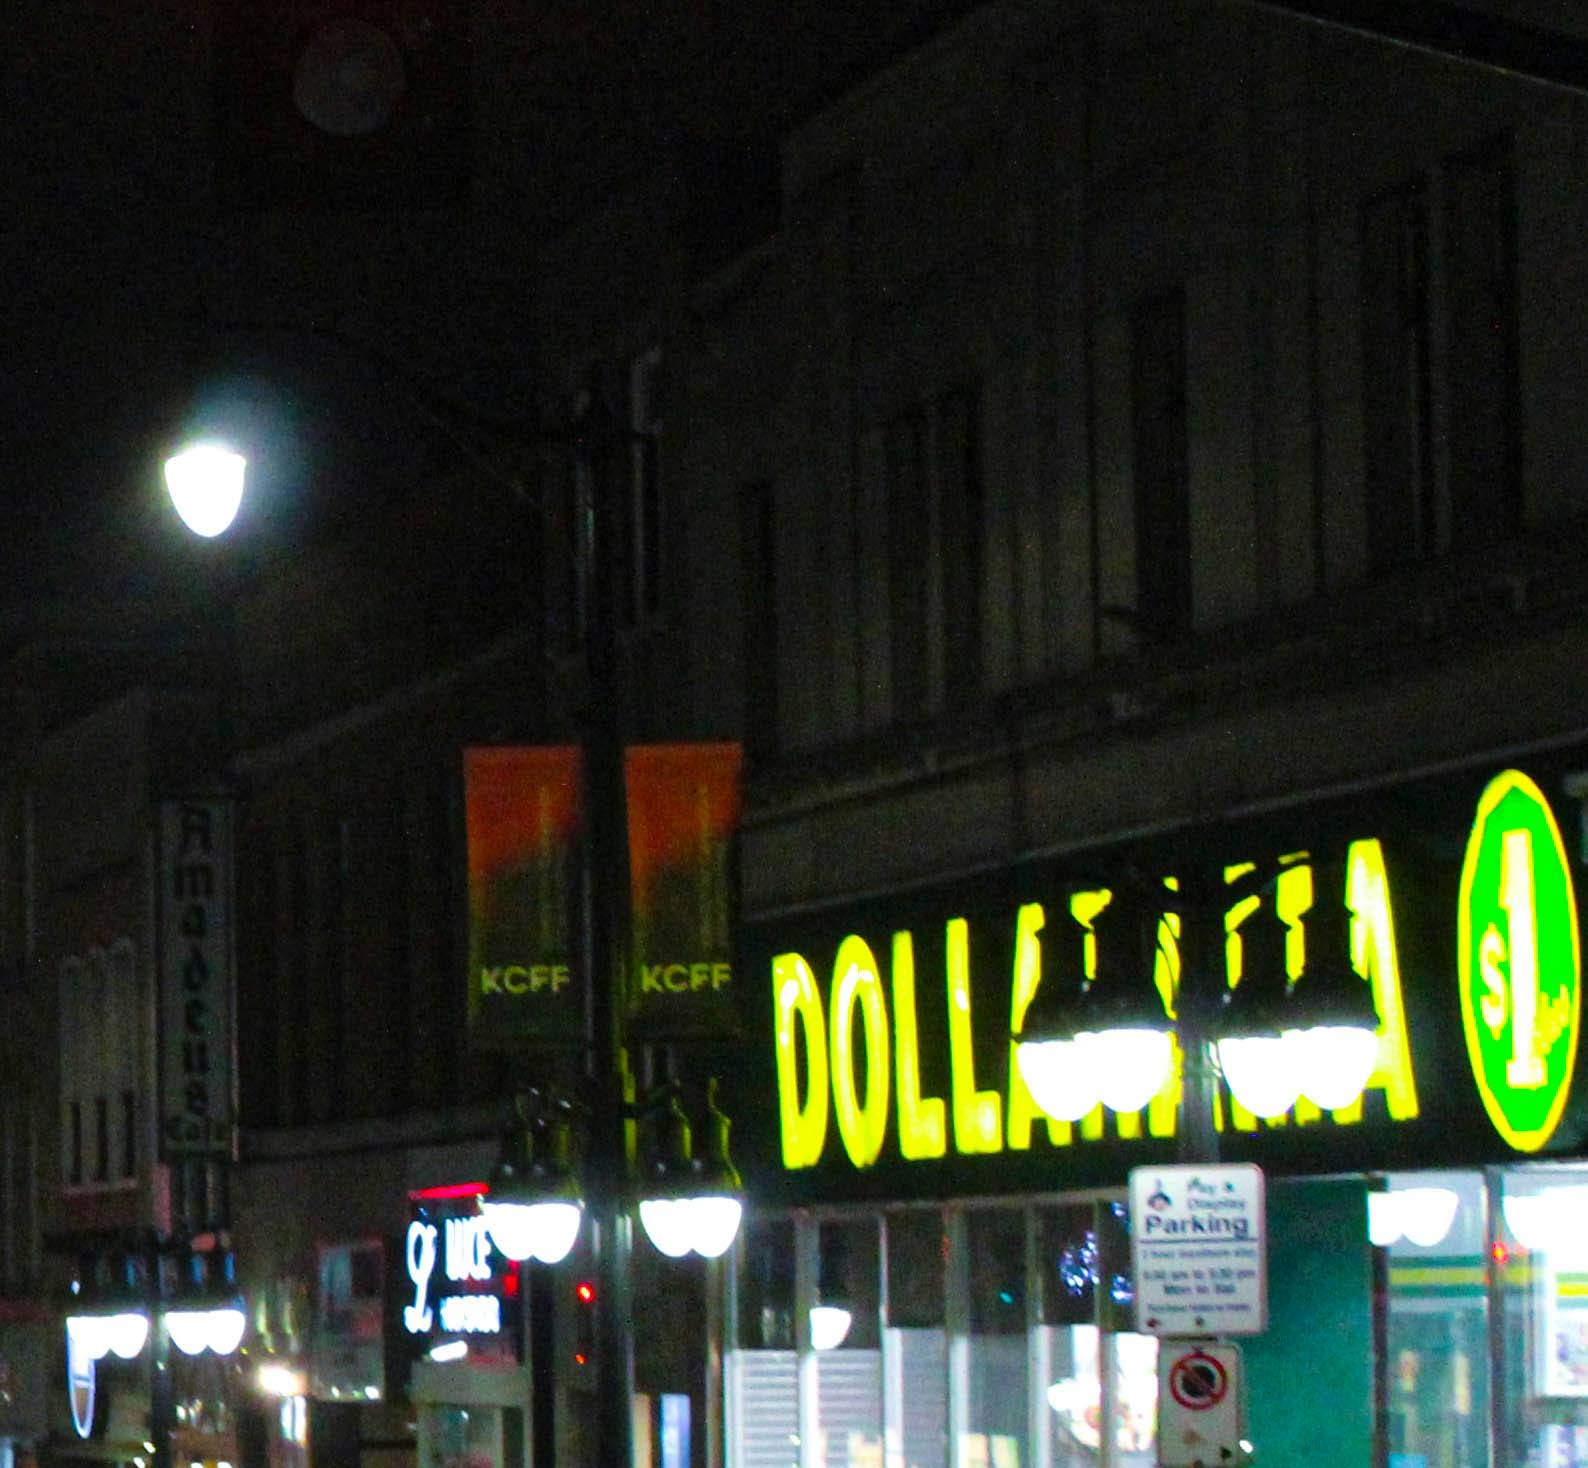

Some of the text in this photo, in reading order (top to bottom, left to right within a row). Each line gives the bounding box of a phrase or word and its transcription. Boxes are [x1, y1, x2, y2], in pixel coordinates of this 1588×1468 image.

[480, 964, 571, 994] KCFF
[640, 962, 733, 994] KCFF
[1144, 1214, 1249, 1241] Parking
